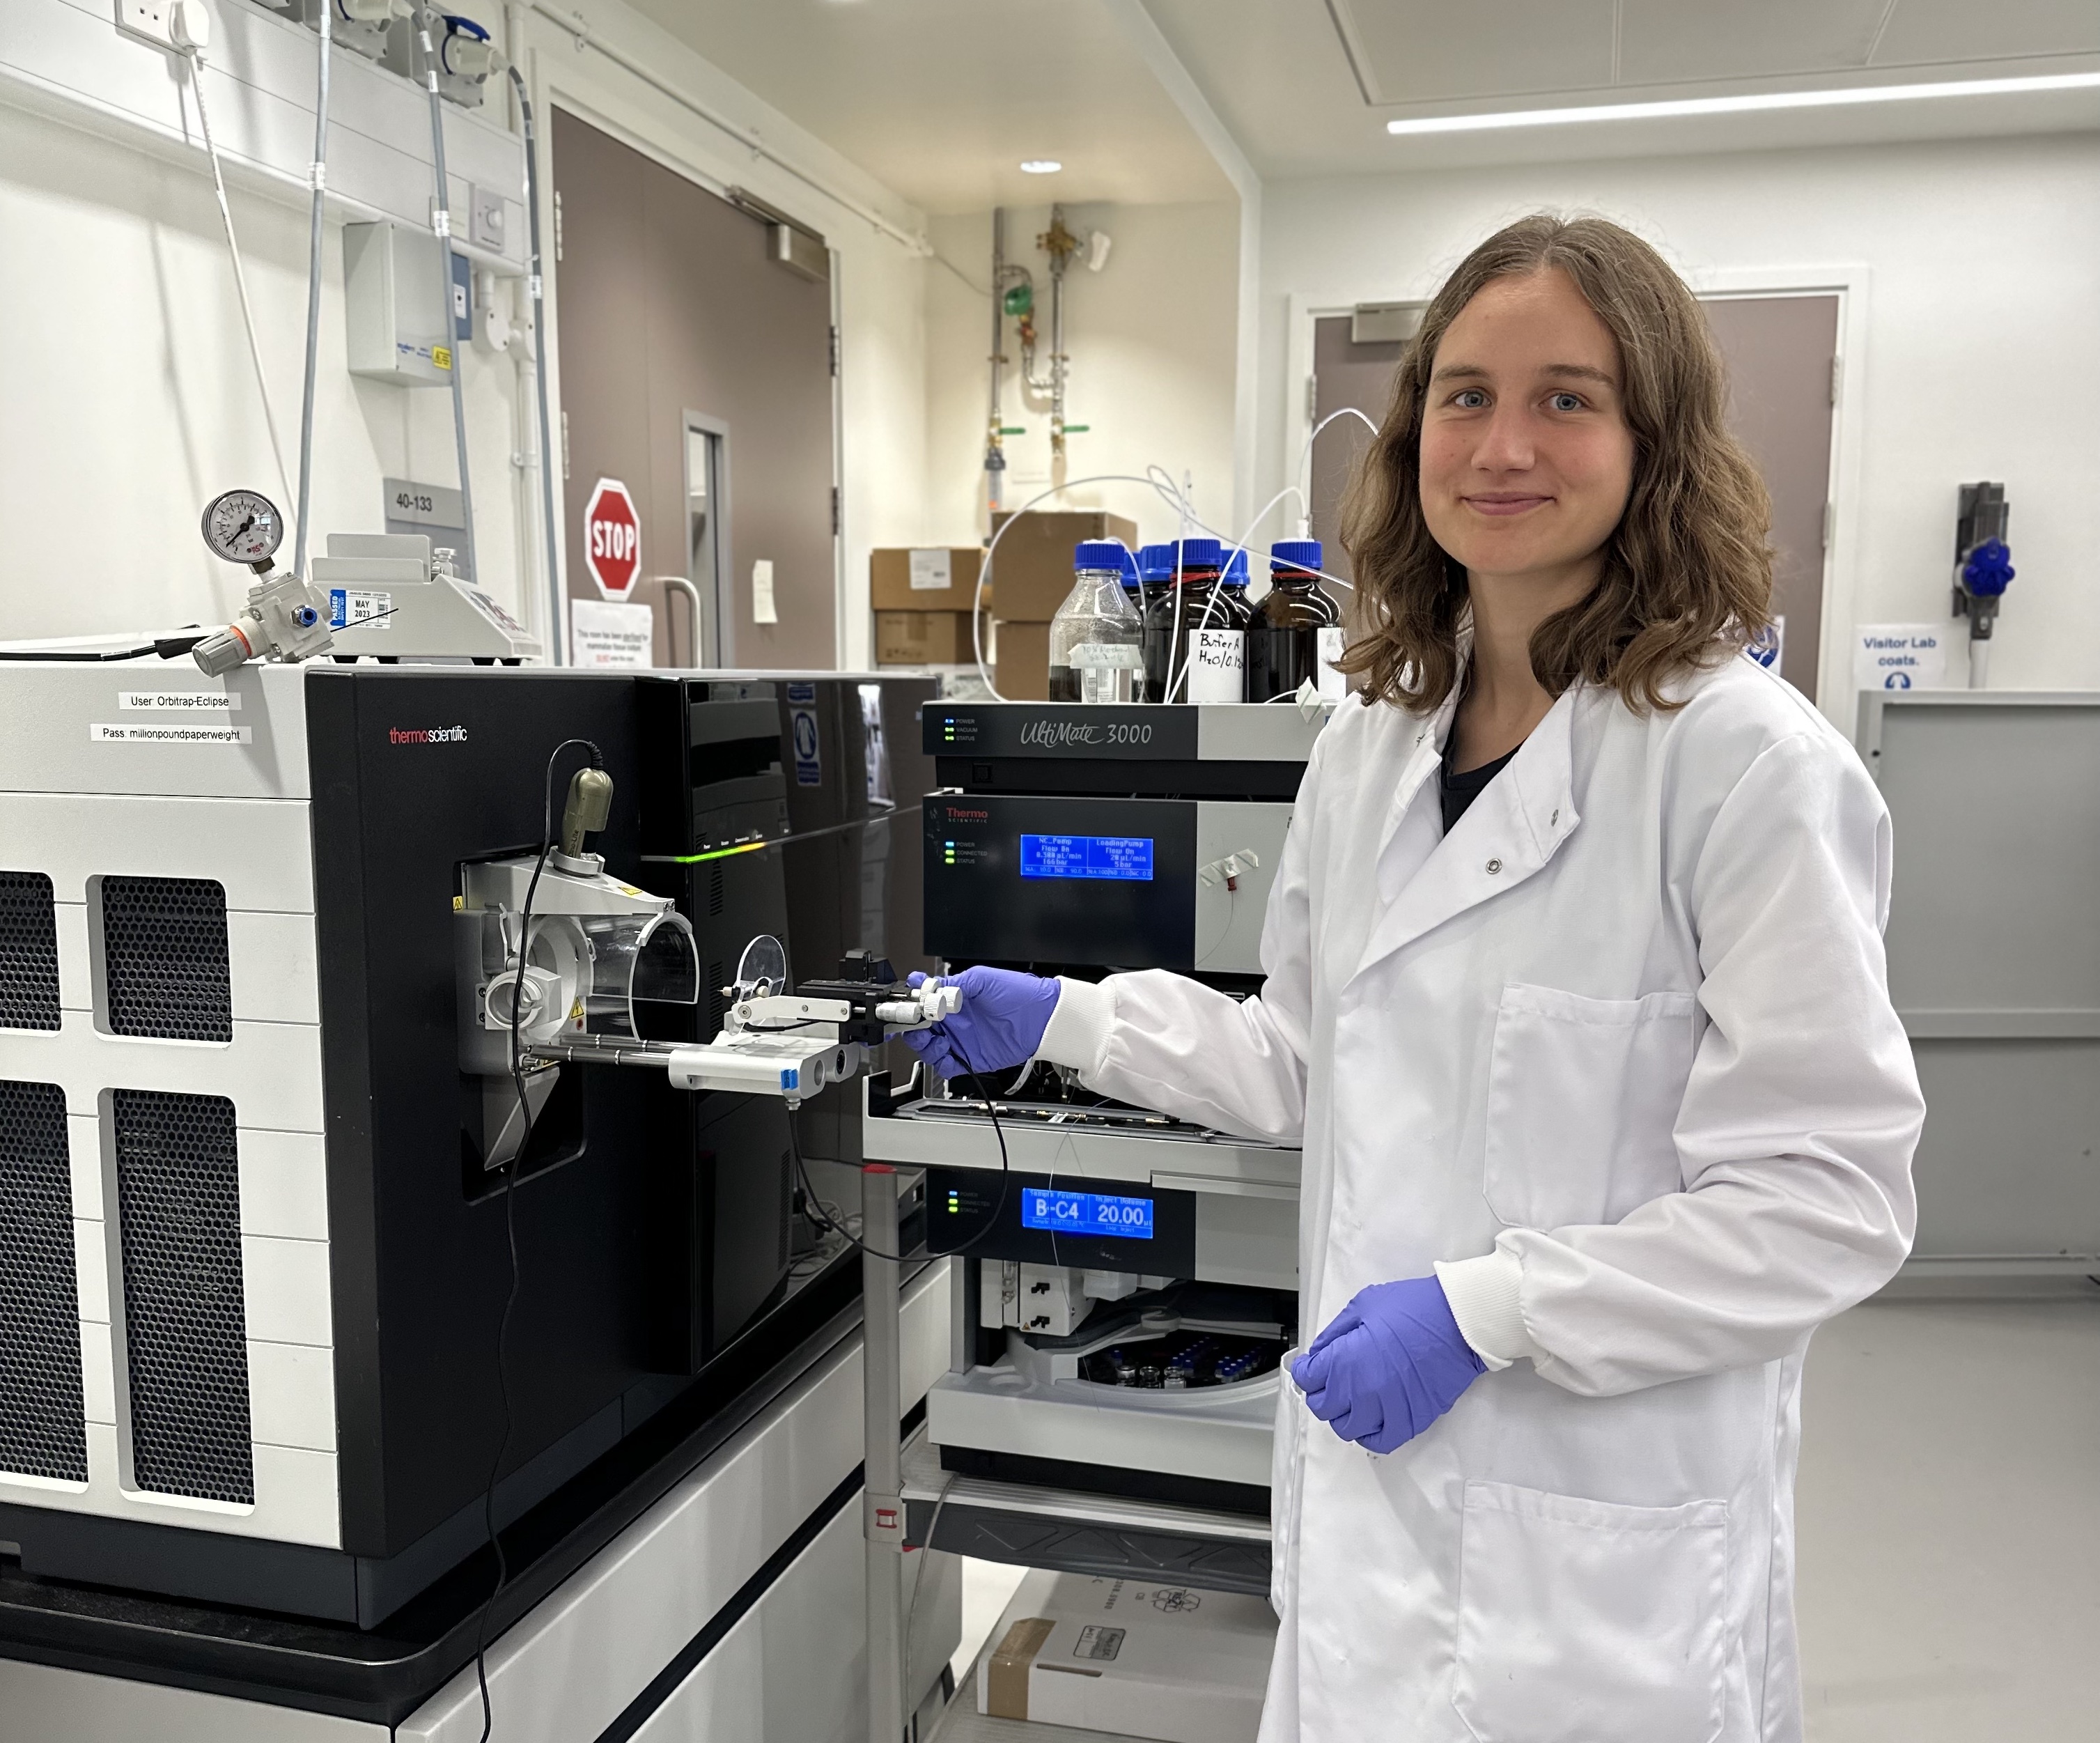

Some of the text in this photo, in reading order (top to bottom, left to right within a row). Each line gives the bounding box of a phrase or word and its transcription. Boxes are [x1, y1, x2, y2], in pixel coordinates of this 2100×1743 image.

[396, 493, 433, 512] 40-133
[593, 520, 635, 561] STOP
[355, 600, 370, 608] MAY
[1234, 637, 1239, 651] A
[1863, 637, 1936, 649] Visitor Lab
[1878, 655, 1920, 666] coats.
[157, 696, 229, 708] Orbitrap-Eclipse
[130, 729, 240, 741] millionpoundpaperweight
[1020, 720, 1152, 748] UltiMate 3000
[947, 807, 988, 818] Thermo
[1096, 839, 1144, 848] LoadingPump
[1036, 1198, 1079, 1219] B-C4
[1098, 1204, 1144, 1225] 20.00
